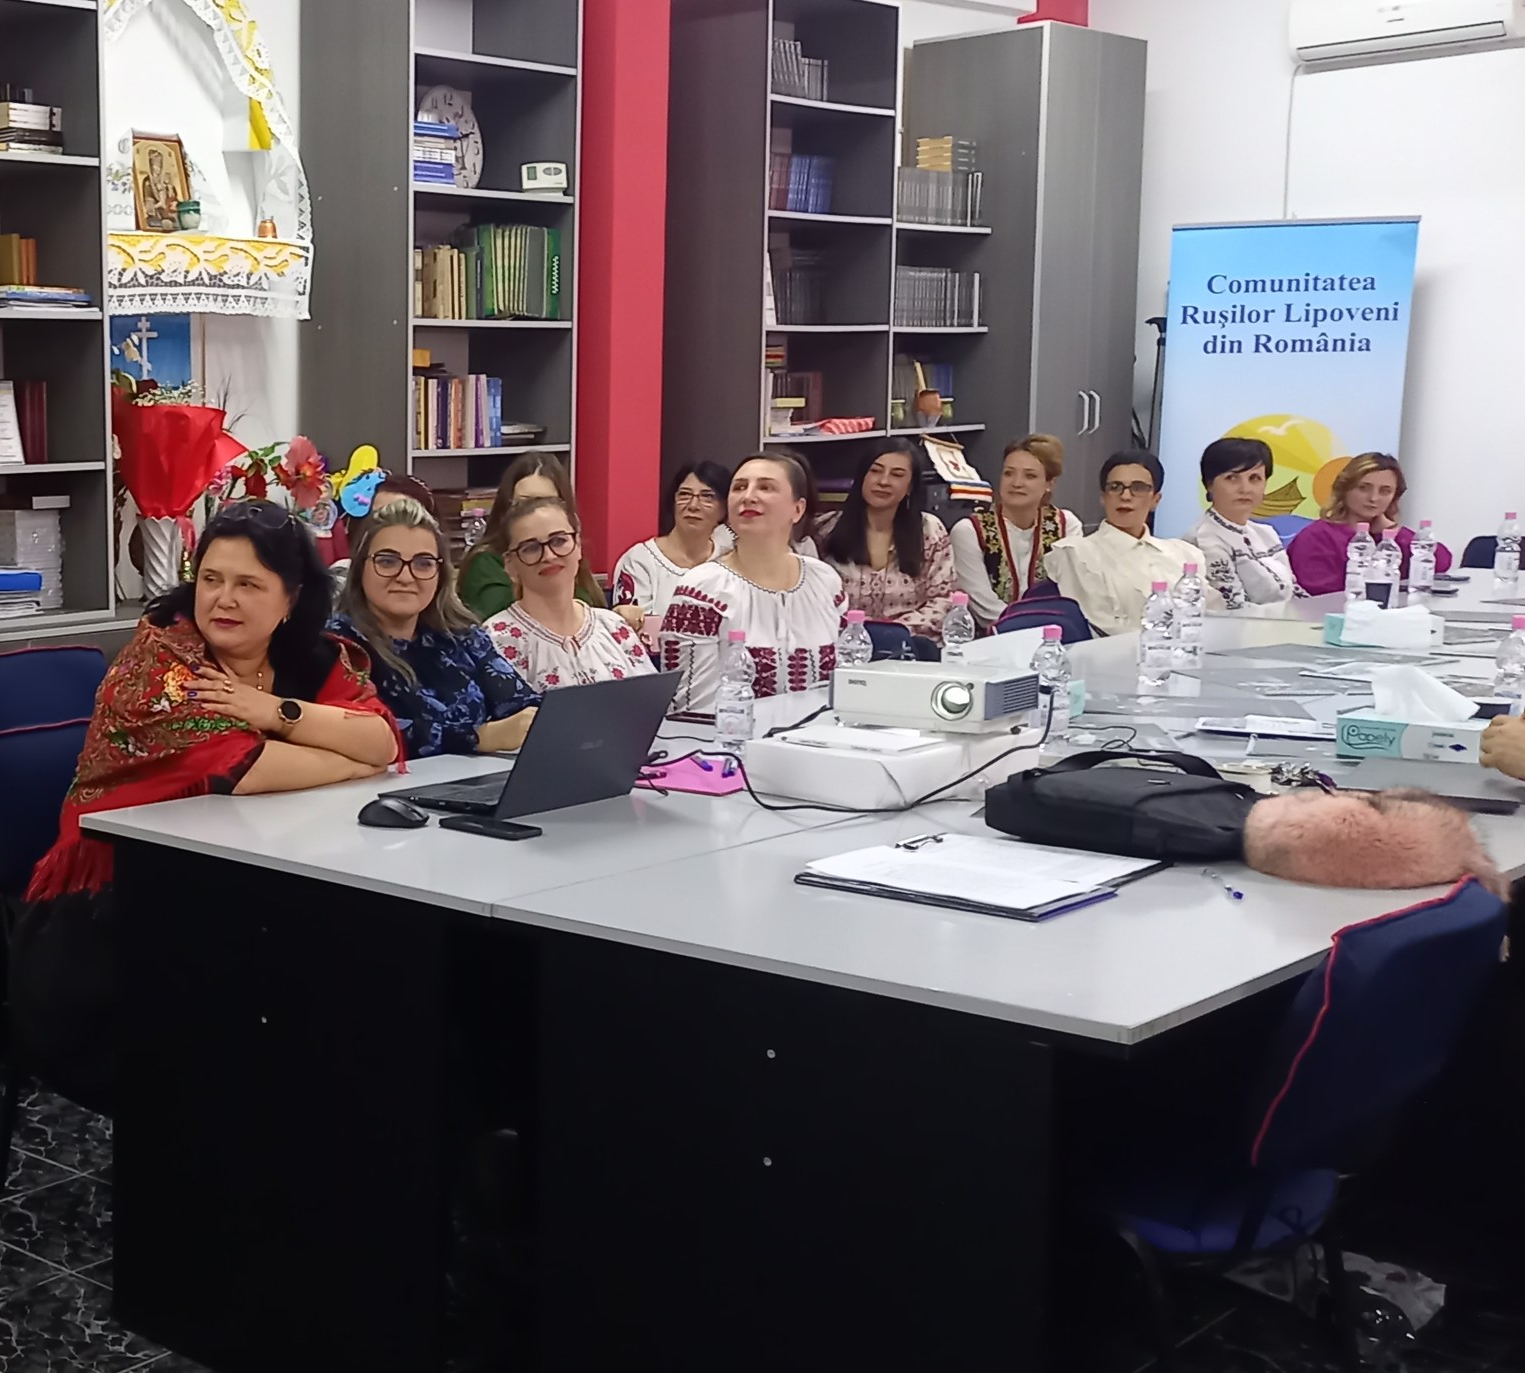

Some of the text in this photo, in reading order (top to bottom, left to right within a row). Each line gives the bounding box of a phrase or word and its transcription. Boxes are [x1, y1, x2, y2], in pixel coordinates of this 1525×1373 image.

[1206, 272, 1377, 295] Comunitatea
[1284, 301, 1400, 328] Lipoveni
[1202, 332, 1372, 354] din România
